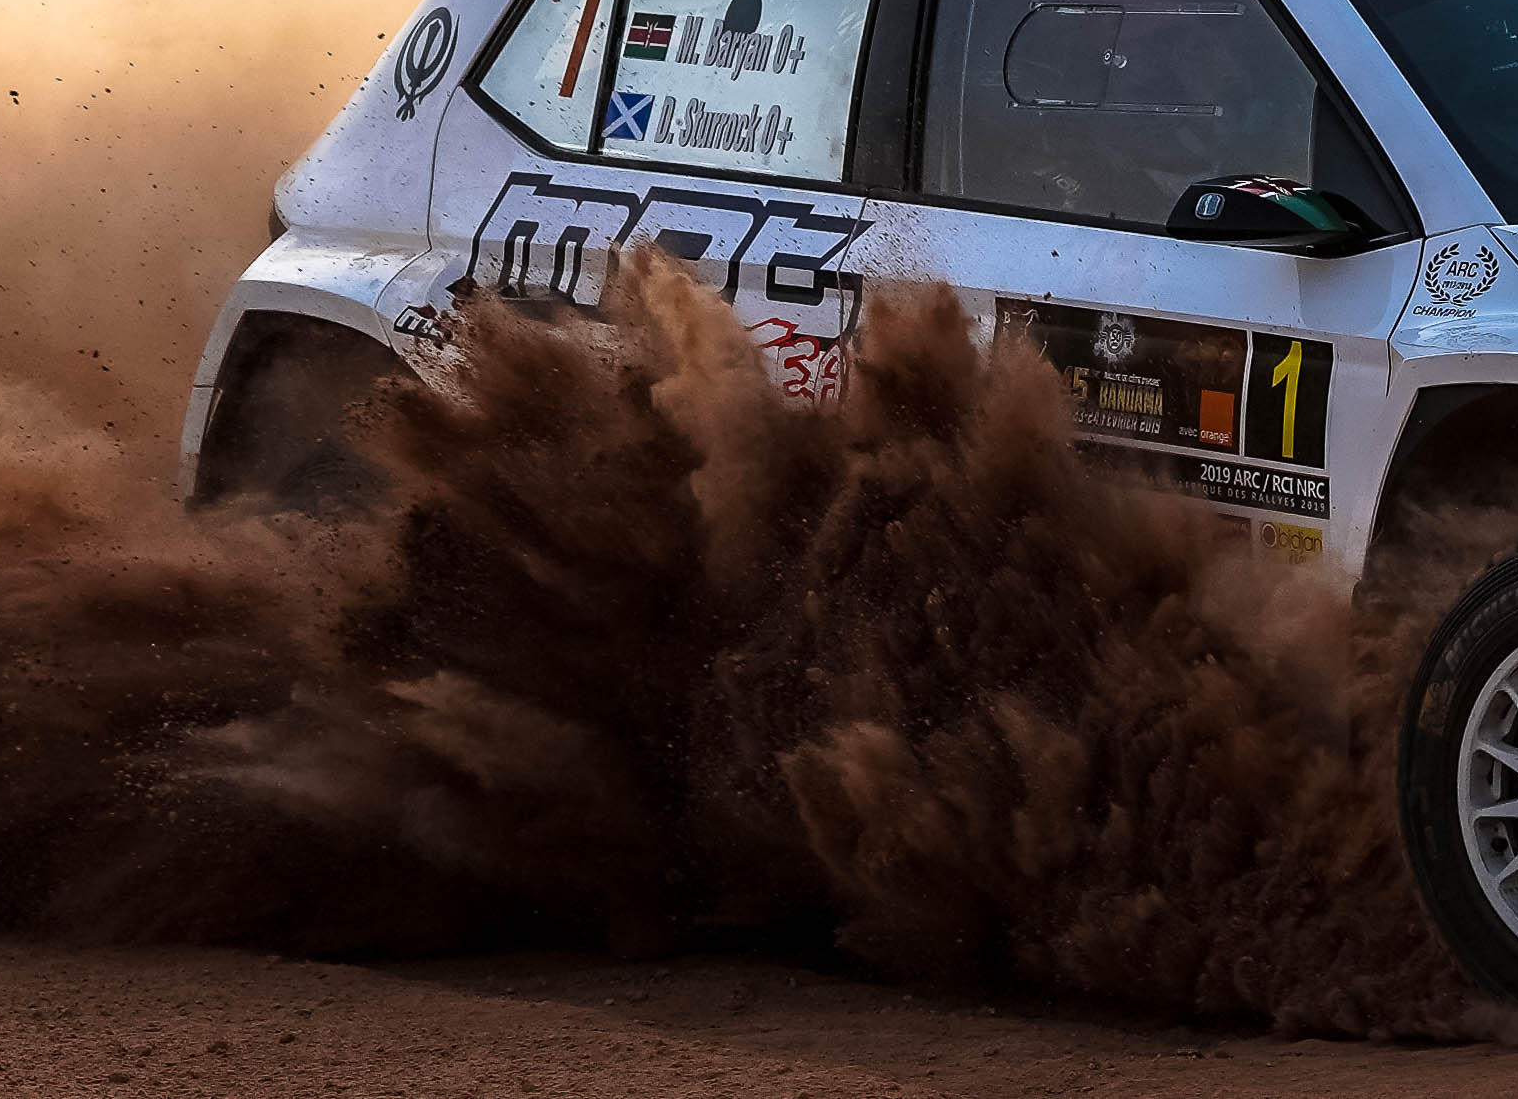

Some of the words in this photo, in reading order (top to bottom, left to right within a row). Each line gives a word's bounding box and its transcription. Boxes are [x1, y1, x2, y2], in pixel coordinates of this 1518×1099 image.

[675, 15, 703, 65] M.
[653, 95, 676, 145] D.
[680, 97, 763, 154] Sturrock
[1445, 260, 1480, 278] ARC
[1412, 305, 1477, 318] CHAMPION
[1271, 340, 1303, 459] 1
[1200, 429, 1229, 444] orange
[1200, 463, 1231, 484] 2019
[1233, 468, 1261, 490] ARC
[1296, 480, 1325, 500] NRC
[1251, 491, 1295, 508] RALLYES
[1300, 500, 1326, 513] 2019
